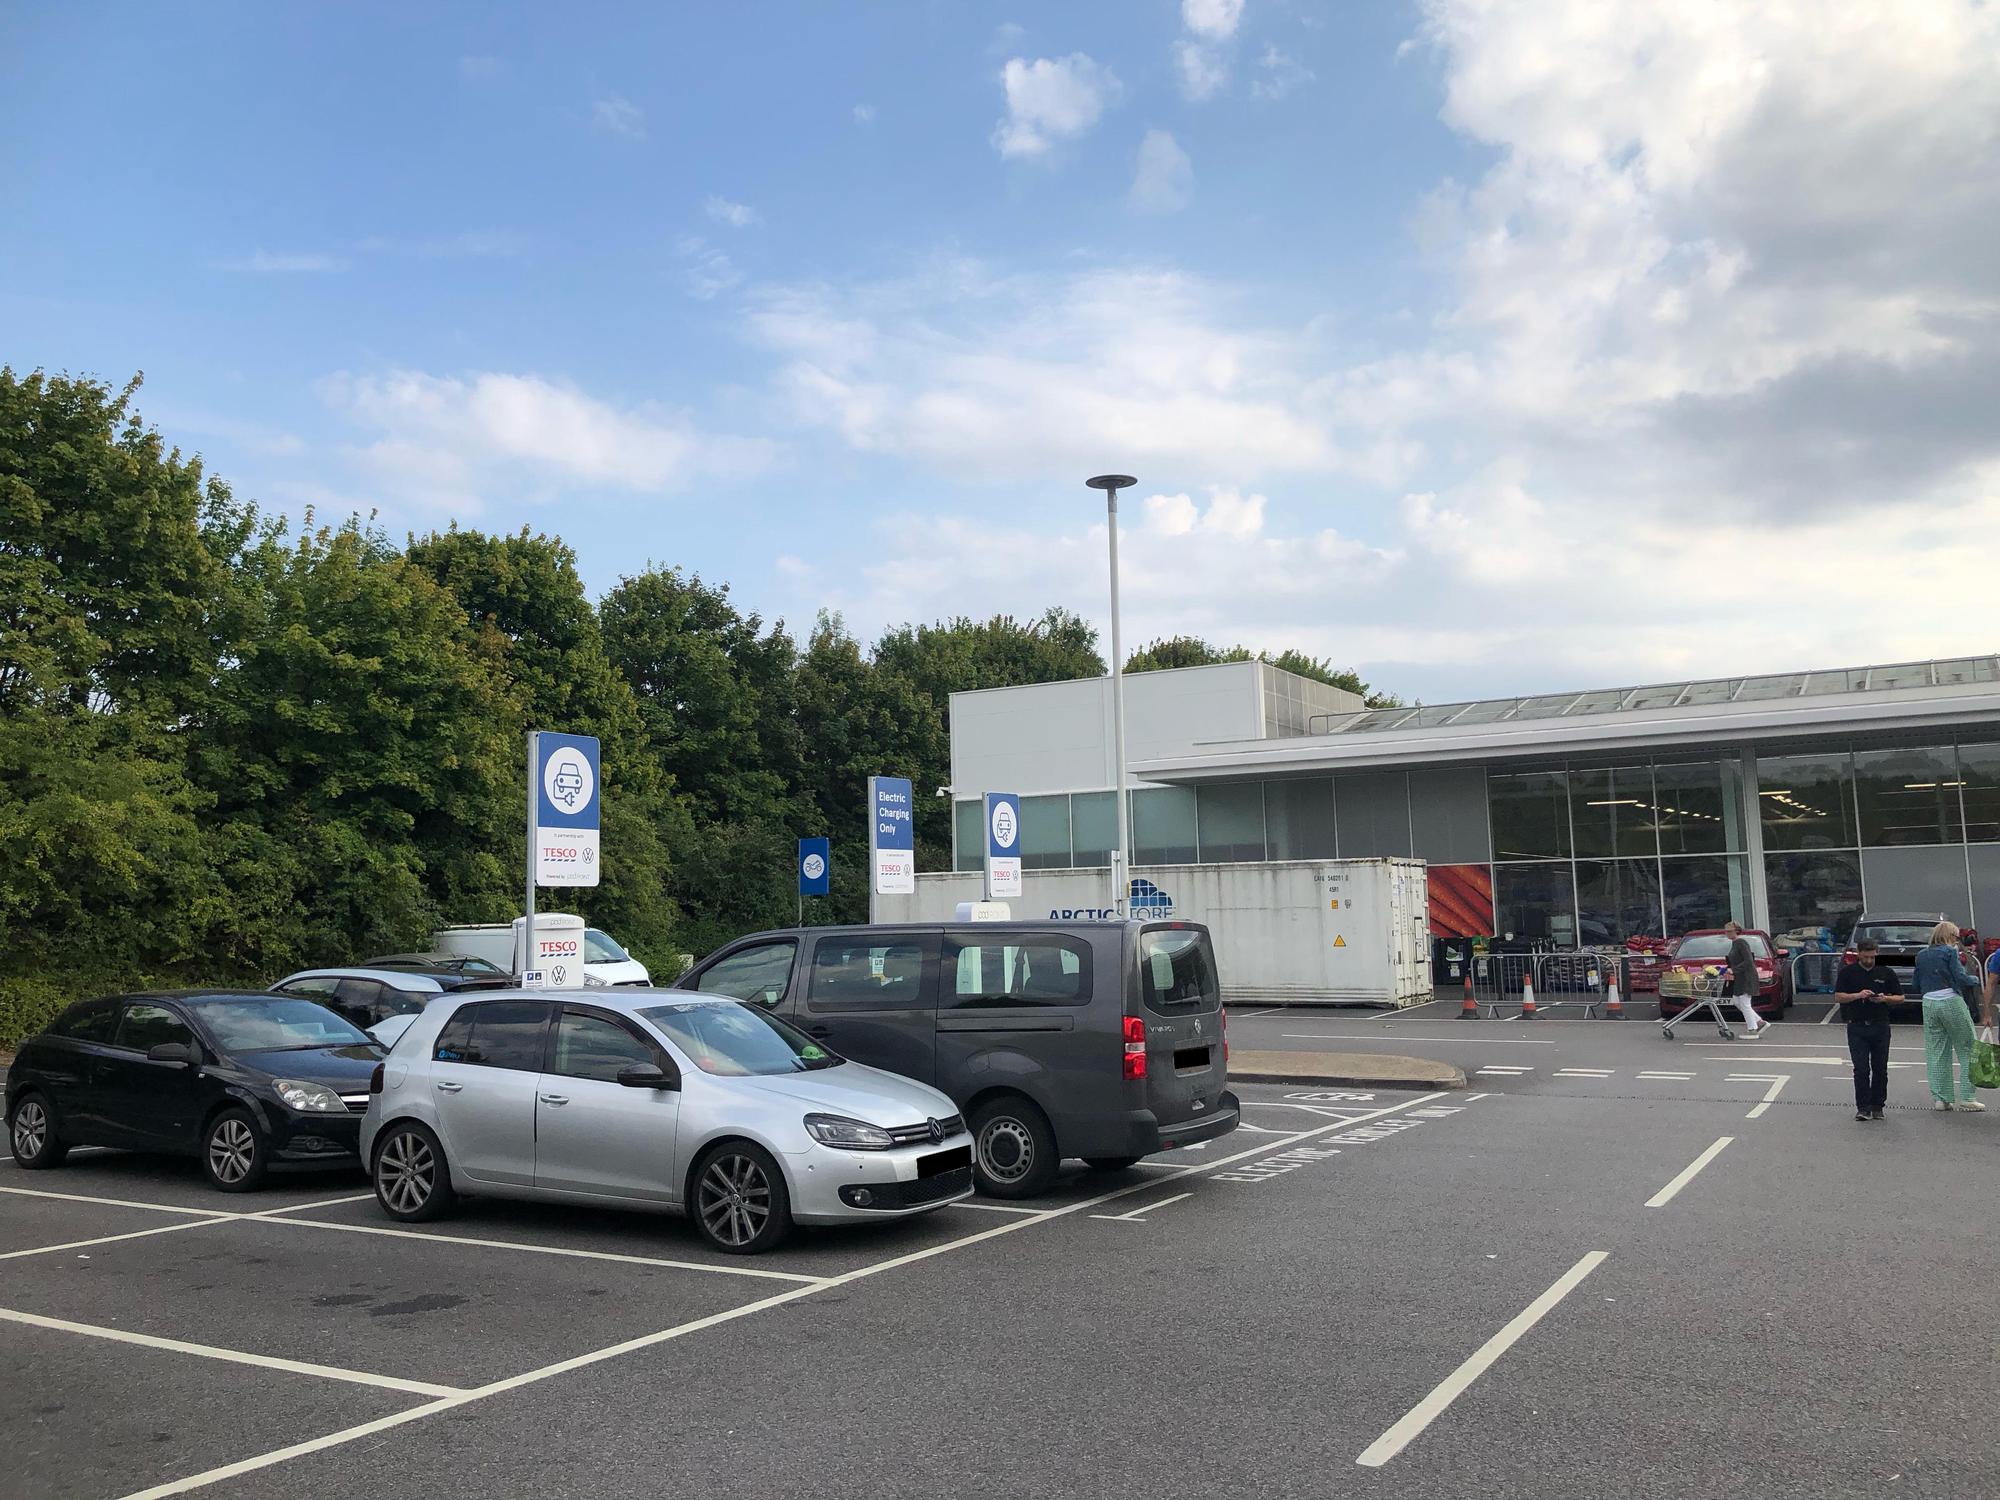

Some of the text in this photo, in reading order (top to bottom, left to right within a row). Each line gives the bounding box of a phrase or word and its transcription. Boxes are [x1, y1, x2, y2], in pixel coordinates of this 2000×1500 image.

[879, 791, 906, 803] Electric
[879, 807, 910, 821] Charging
[880, 823, 896, 836] Only
[543, 847, 577, 858] TESCO
[881, 864, 901, 872] TESCO
[993, 870, 1011, 878] TESCO
[540, 940, 577, 952] TESCO
